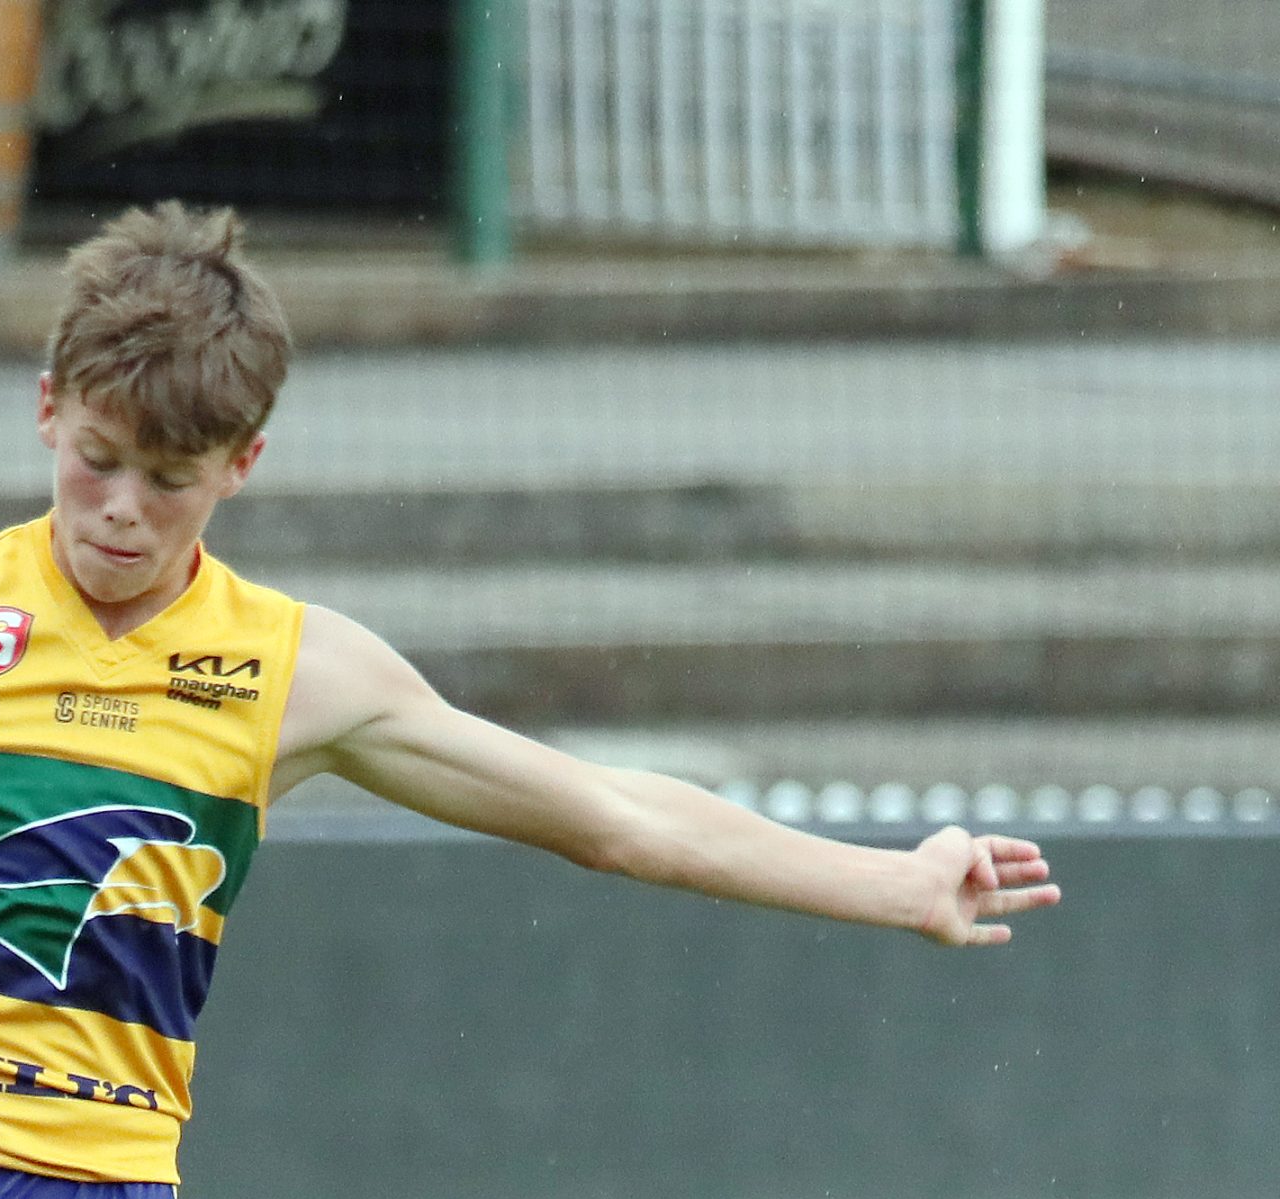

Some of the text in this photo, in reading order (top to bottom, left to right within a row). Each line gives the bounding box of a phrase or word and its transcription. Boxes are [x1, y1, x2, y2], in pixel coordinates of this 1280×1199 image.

[168, 652, 261, 679] KIA
[170, 676, 260, 701] maughan
[81, 693, 140, 716] SPORTS
[79, 711, 139, 733] CENTRE
